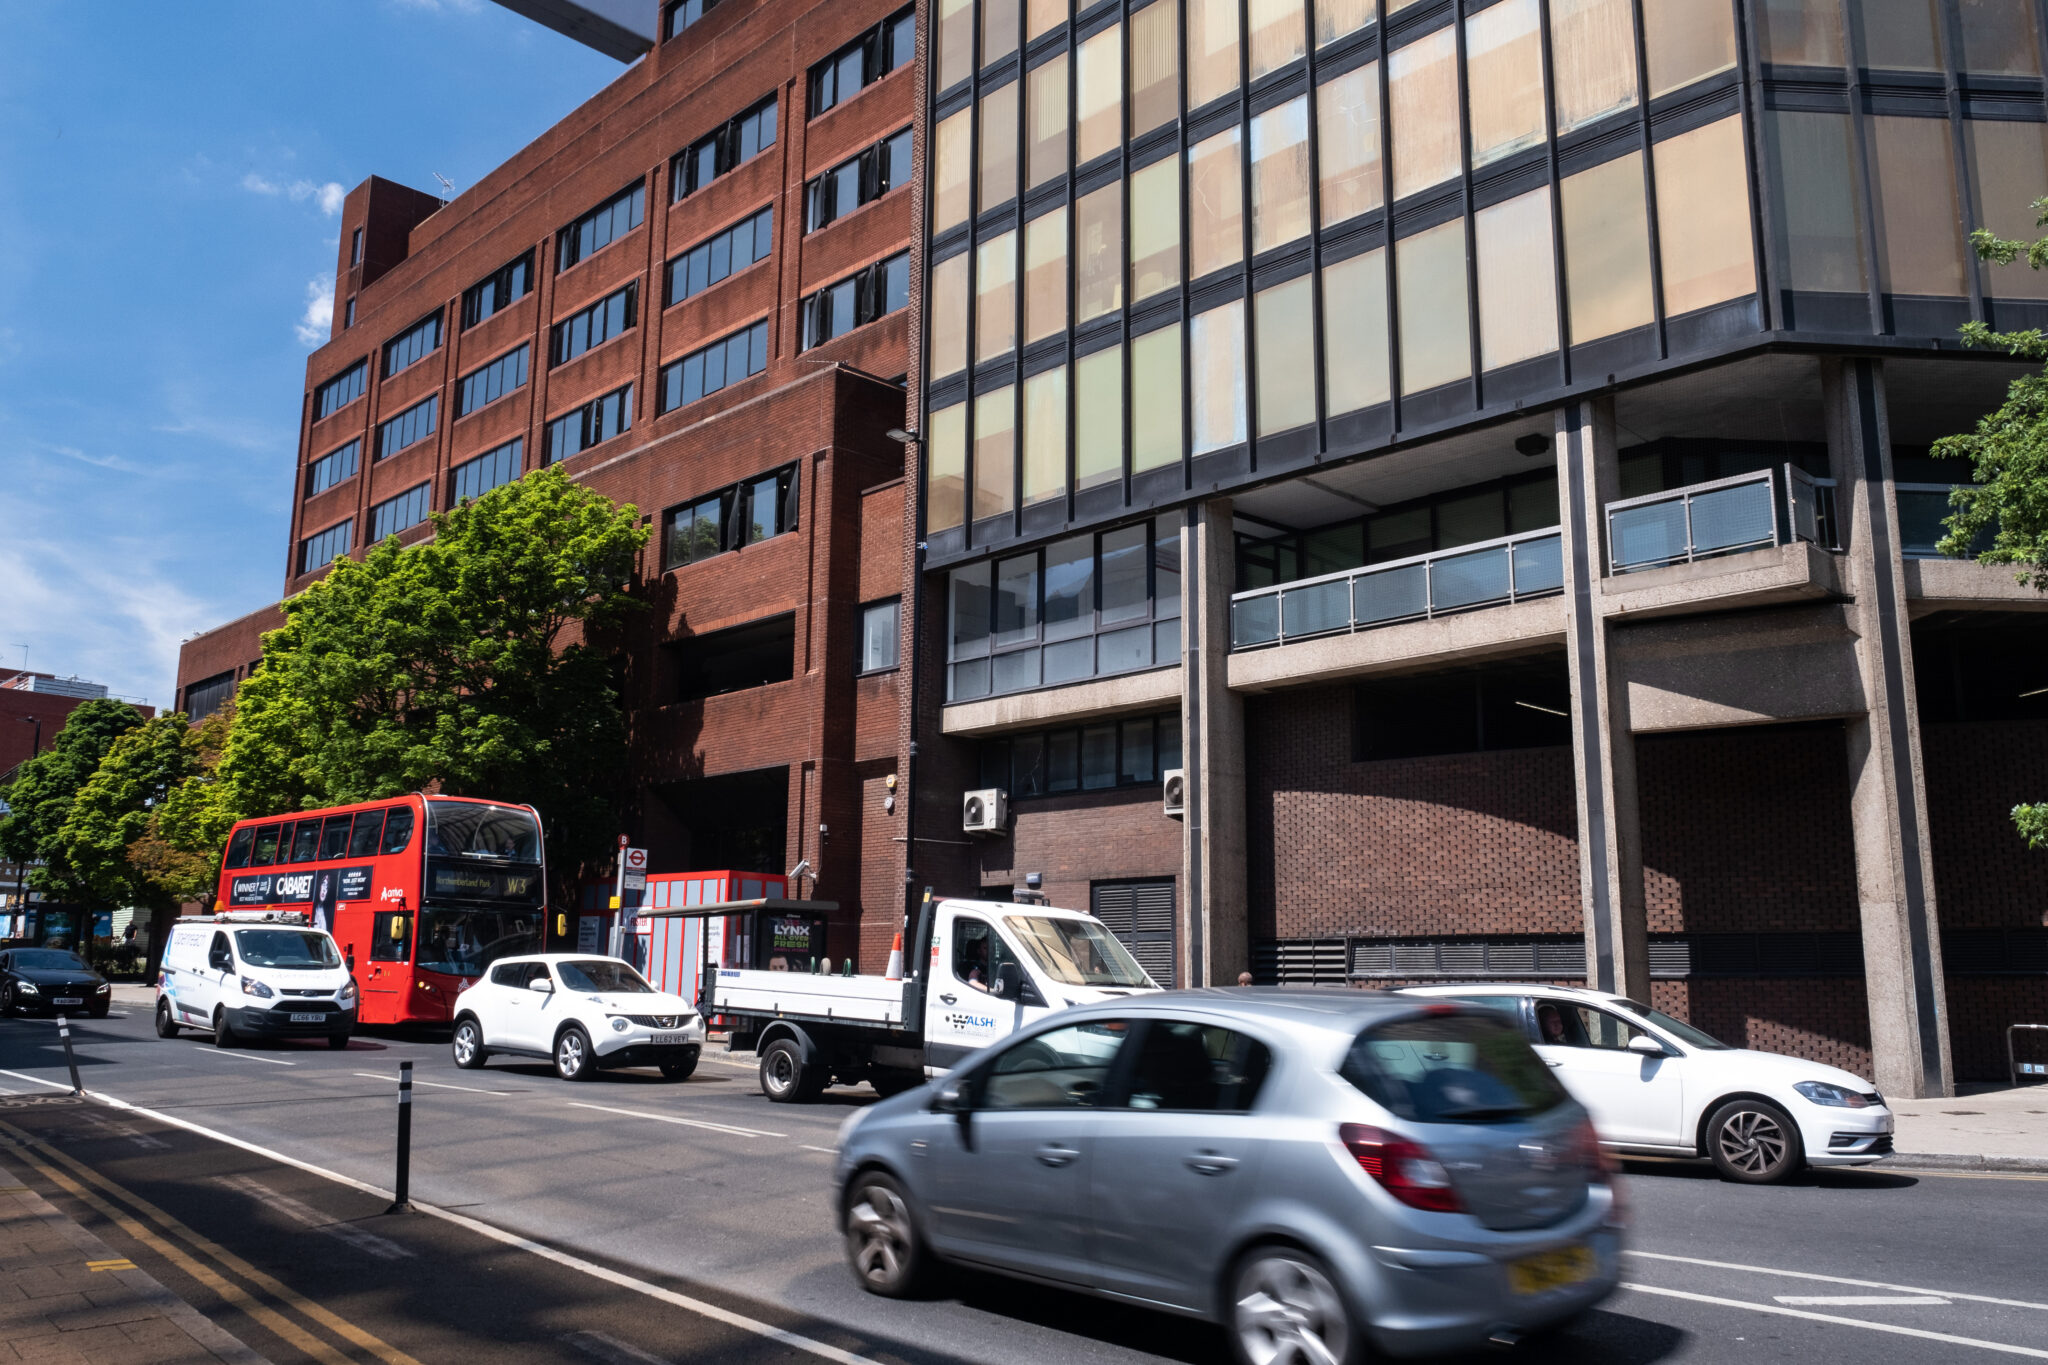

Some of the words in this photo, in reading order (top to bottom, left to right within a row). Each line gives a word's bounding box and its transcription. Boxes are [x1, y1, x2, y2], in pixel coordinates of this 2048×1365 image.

[621, 835, 628, 845] B
[276, 875, 314, 895] CABARET
[436, 876, 478, 887] Northumberland
[480, 879, 490, 887] Park
[508, 878, 526, 894] W3
[237, 883, 256, 892] WINNER
[774, 925, 810, 936] LYNX
[952, 1013, 993, 1030] WALSH
